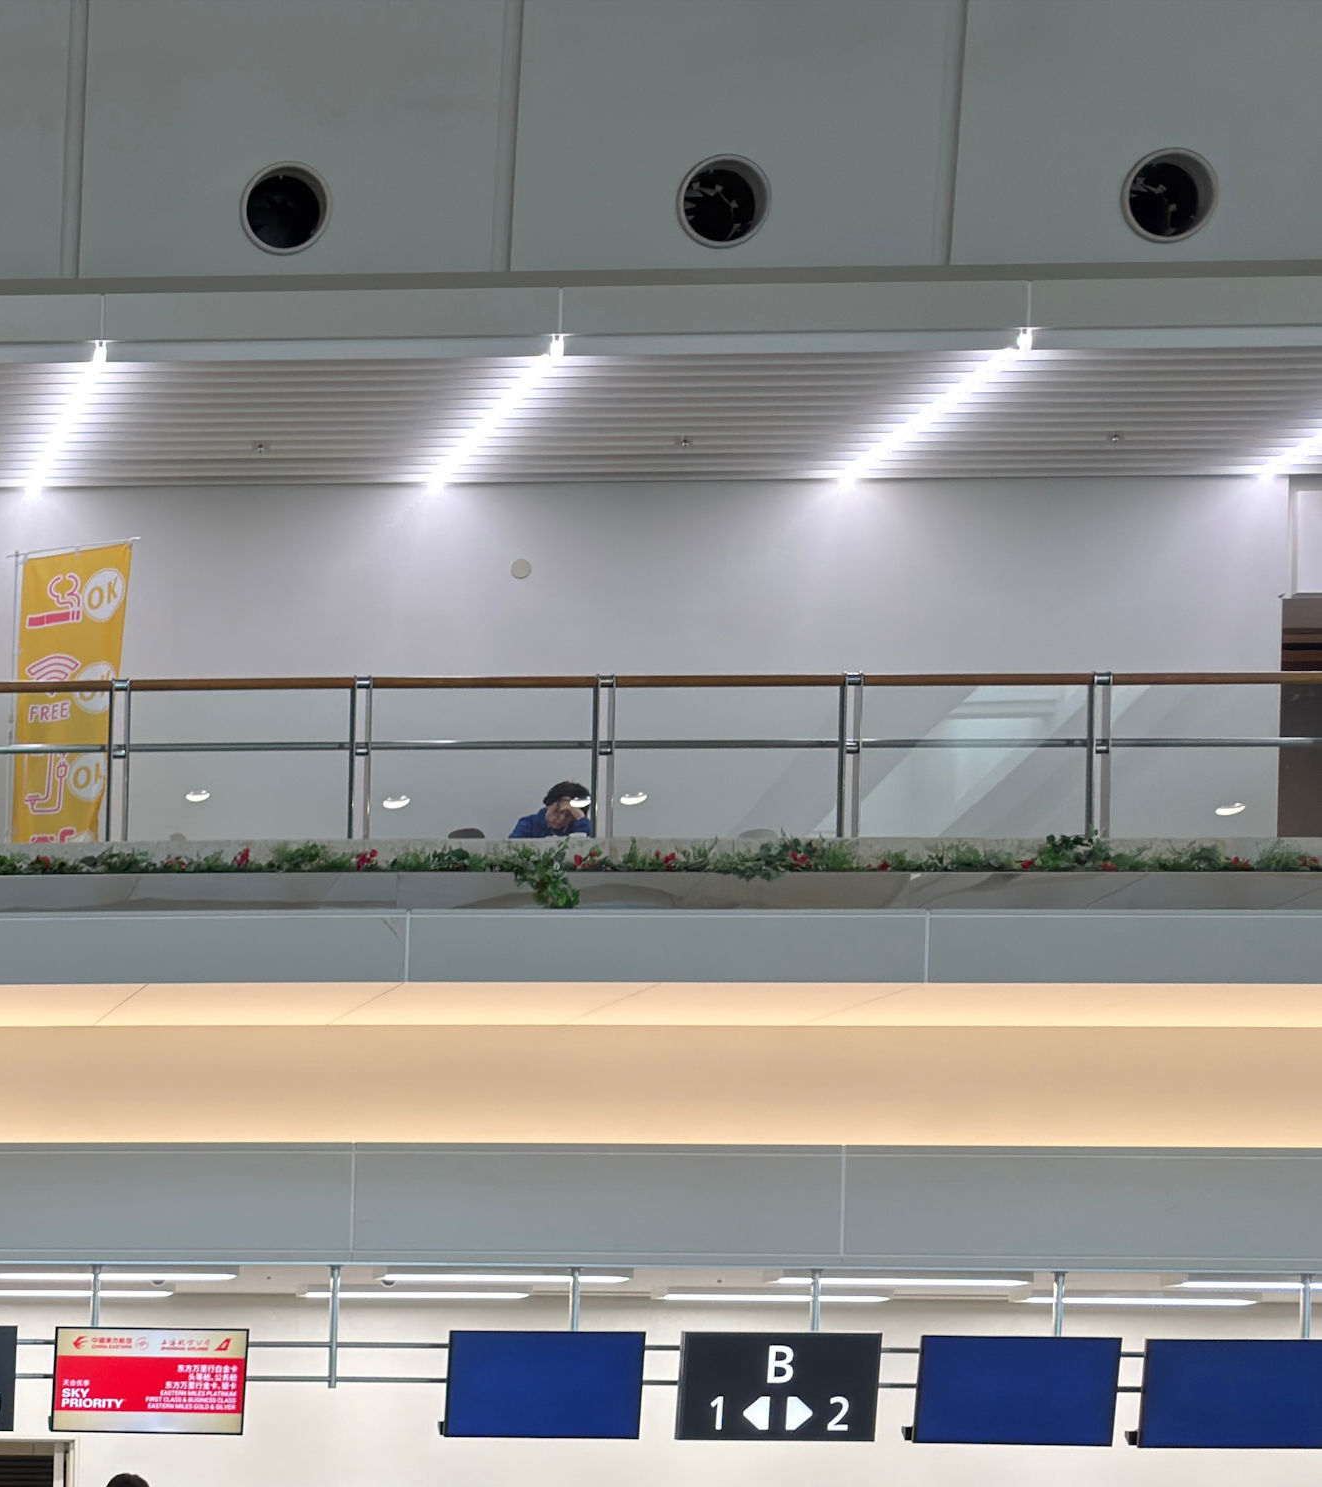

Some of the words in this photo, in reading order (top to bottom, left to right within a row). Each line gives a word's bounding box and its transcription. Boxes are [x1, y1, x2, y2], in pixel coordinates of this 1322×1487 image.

[88, 576, 118, 610] OK
[29, 703, 70, 722] FREE
[767, 1345, 794, 1383] B
[61, 1398, 124, 1408] PRIORITY
[62, 1388, 89, 1398] SKY
[711, 1396, 724, 1430] 1
[827, 1396, 849, 1431] 2
